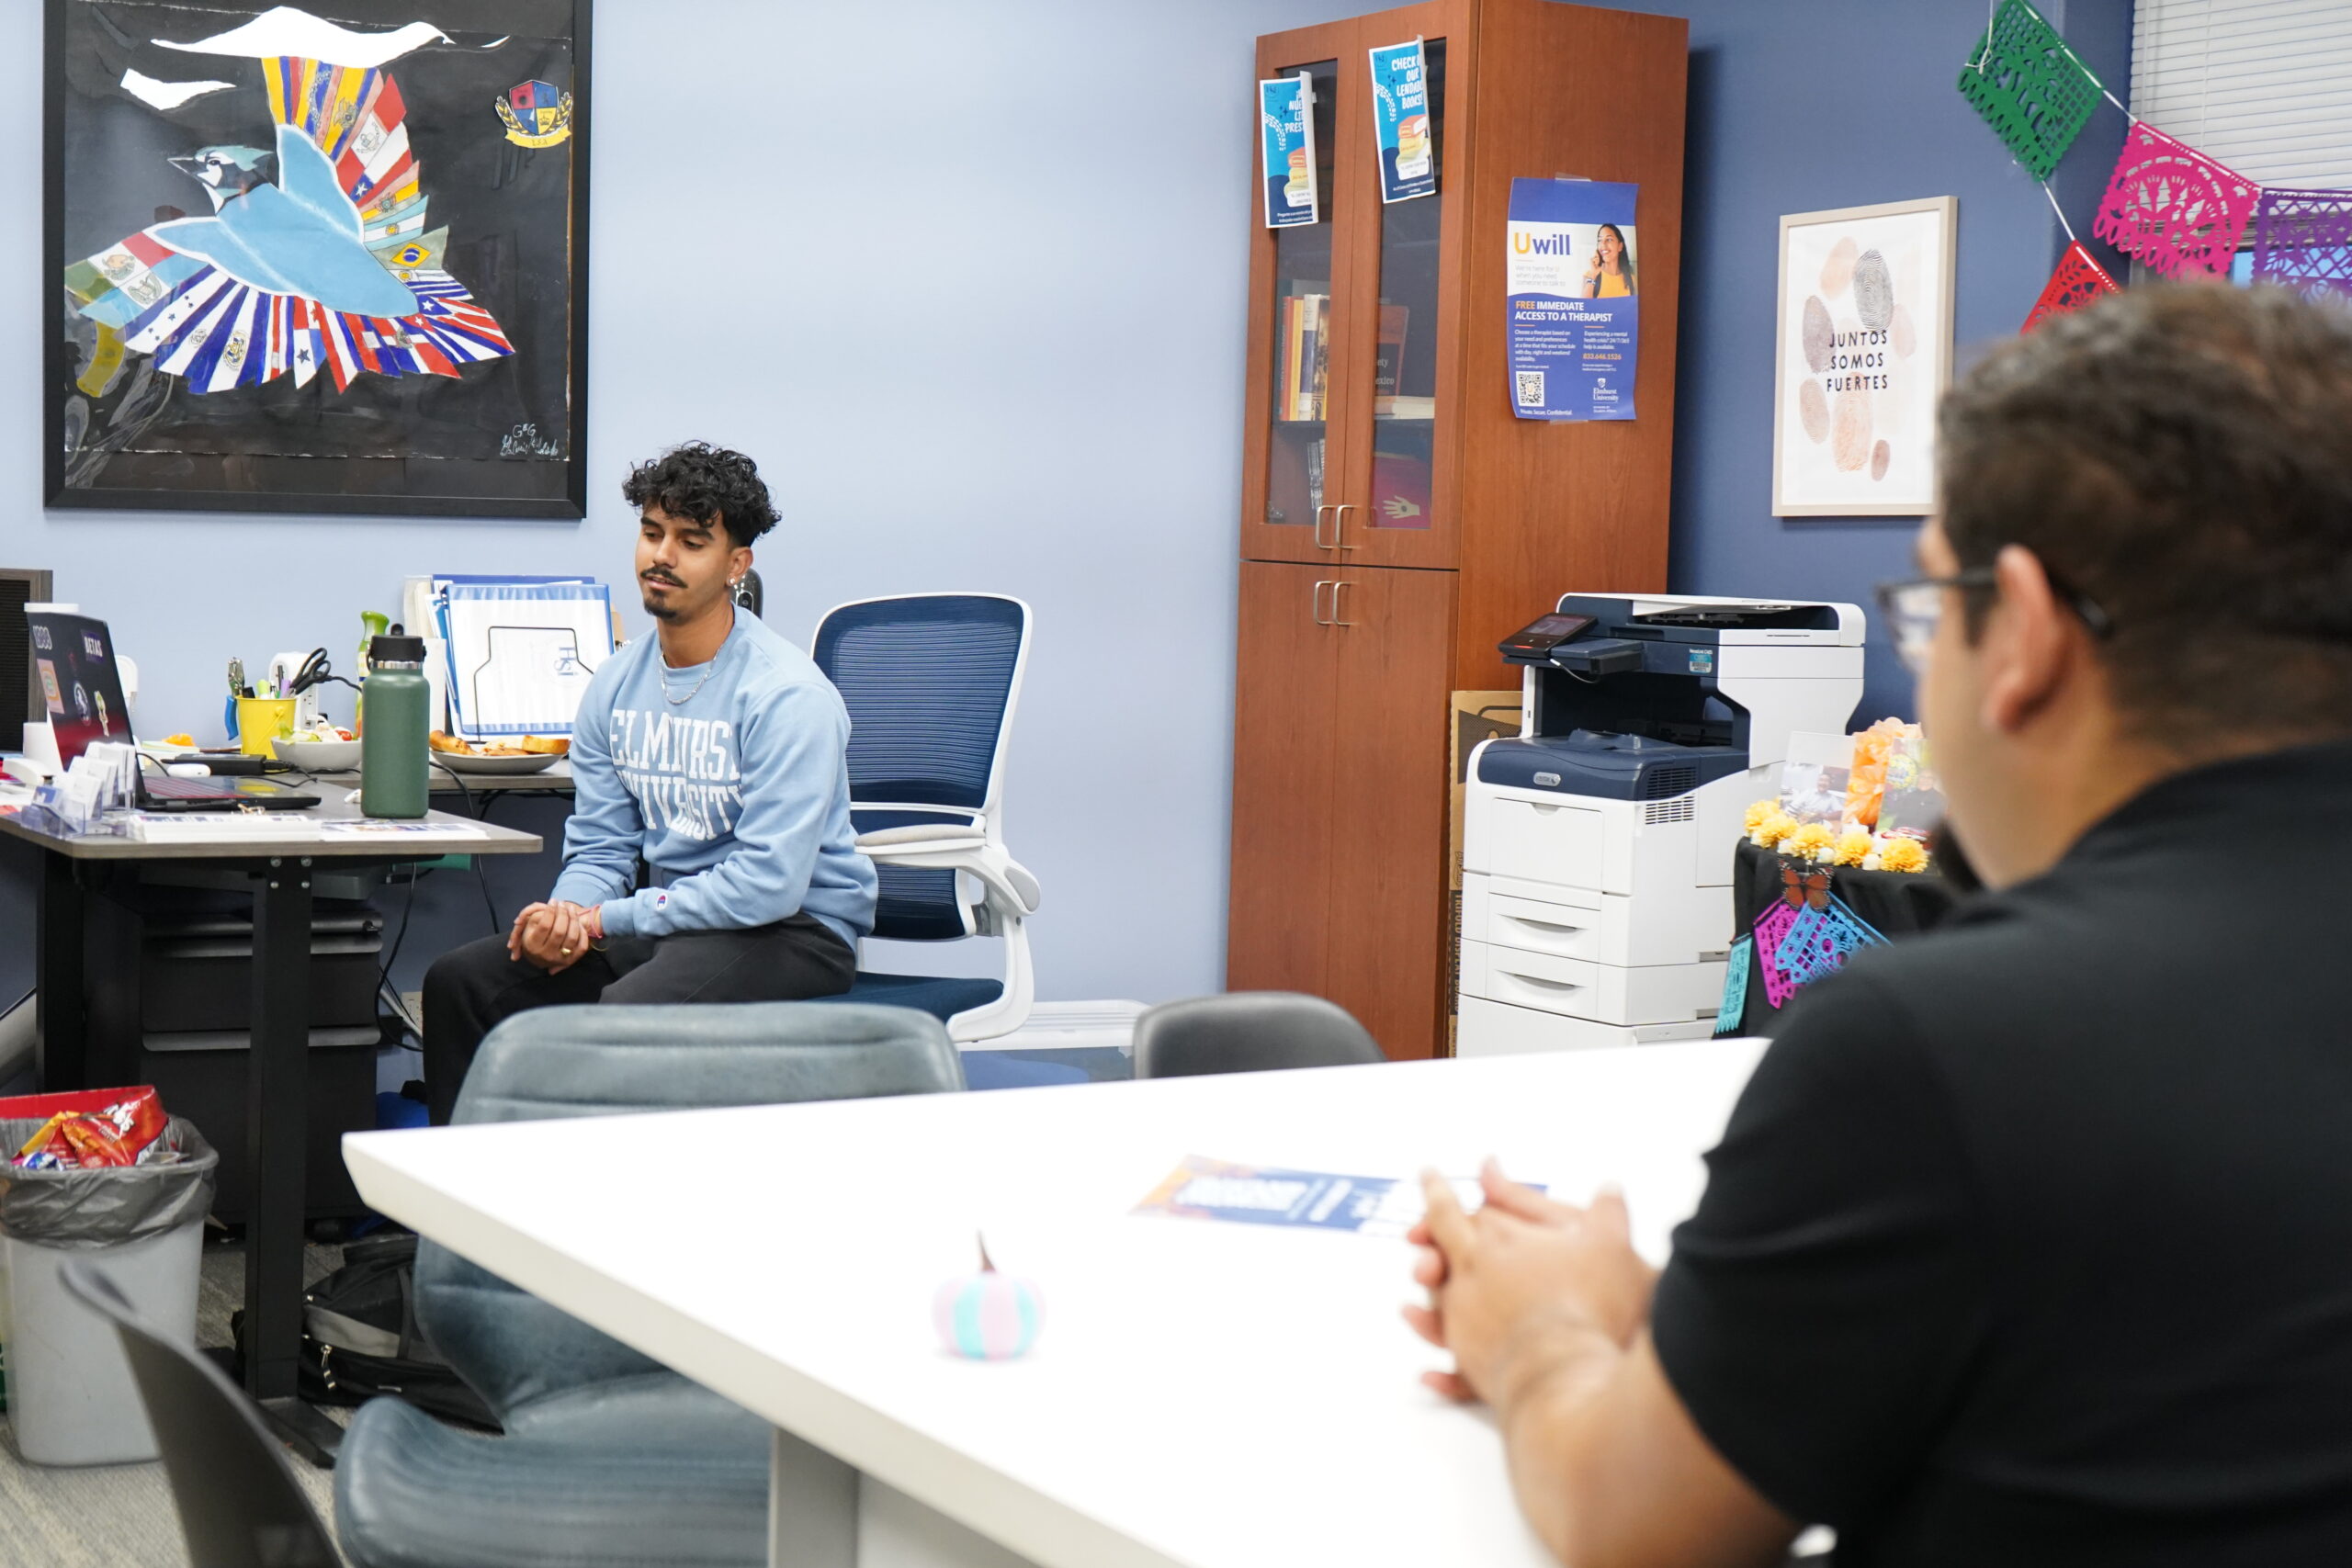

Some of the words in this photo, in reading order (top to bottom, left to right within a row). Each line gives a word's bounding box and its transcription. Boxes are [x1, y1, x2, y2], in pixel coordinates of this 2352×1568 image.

[1392, 56, 1416, 71] CHECK
[1514, 231, 1570, 255] Uwill
[1515, 300, 1535, 310] FREE
[1537, 301, 1584, 310] IMMEDIATE
[1515, 311, 1545, 321] ACCESS
[1547, 312, 1559, 321] TO
[1560, 312, 1567, 321] A
[1568, 313, 1612, 322] THERAPIST
[1829, 330, 1887, 348] JUNTOS
[1831, 353, 1883, 369] SOMOS
[1826, 375, 1887, 392] FUERTES
[84, 636, 104, 657] BETAS
